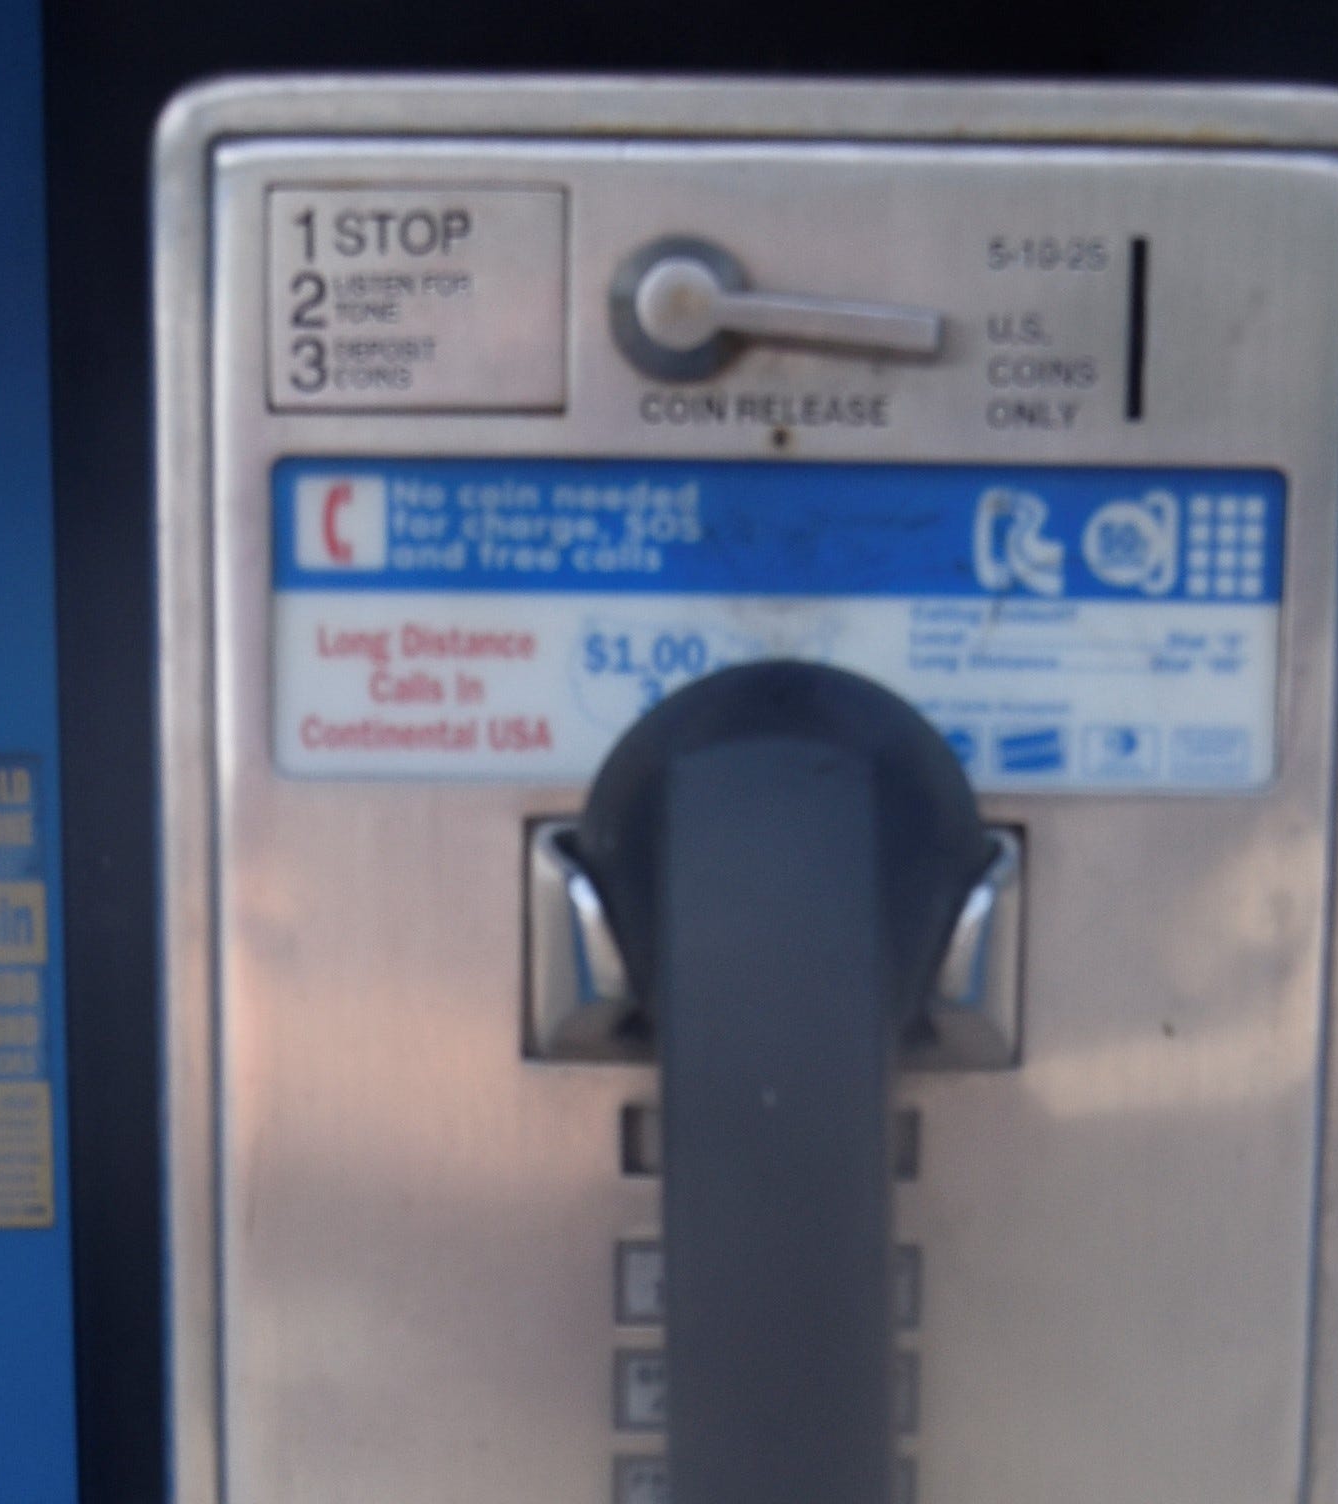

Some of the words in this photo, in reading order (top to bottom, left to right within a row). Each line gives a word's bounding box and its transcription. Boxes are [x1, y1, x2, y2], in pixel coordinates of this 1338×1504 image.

[292, 209, 316, 263] 1
[334, 208, 473, 257] STOP
[291, 270, 327, 330] 2
[290, 334, 327, 393] 3
[987, 354, 1099, 390] COINS
[639, 393, 727, 427] COIN
[736, 394, 890, 428] RELEASE
[986, 397, 1080, 431] ONLY
[457, 479, 541, 510] coin
[551, 479, 701, 510] needed
[478, 539, 562, 572] free
[569, 541, 664, 573] calls
[316, 625, 391, 670] Long
[400, 623, 539, 660] Distance
[583, 632, 708, 674] $1.00
[367, 671, 446, 704] Calls
[300, 715, 479, 752] Continental
[487, 717, 554, 752] USA
